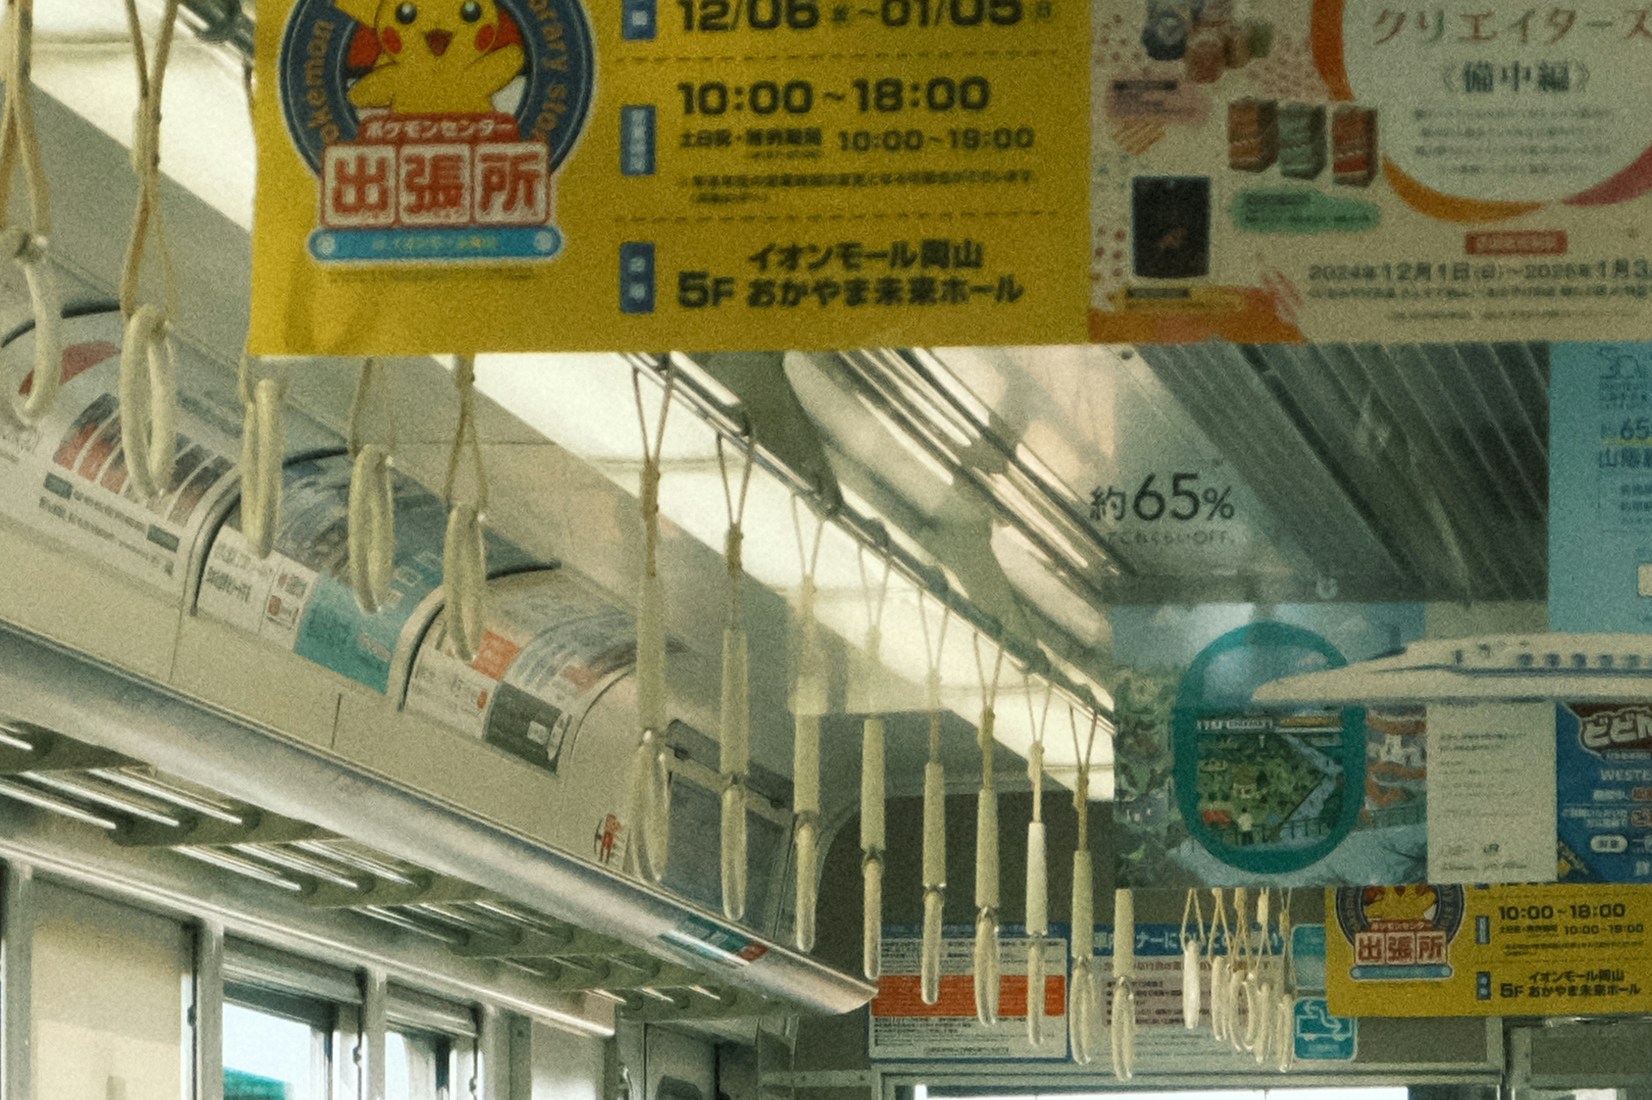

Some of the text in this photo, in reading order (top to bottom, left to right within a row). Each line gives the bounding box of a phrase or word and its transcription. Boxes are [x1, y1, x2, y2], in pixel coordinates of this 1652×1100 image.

[364, 120, 514, 139] ポケモンセンター
[333, 151, 540, 215] 出張所
[748, 238, 985, 272] イオンモール岡山
[677, 271, 735, 309] 5F
[747, 276, 1026, 309] おかやま未来ホール
[1089, 472, 1235, 521] 約65%
[1357, 936, 1445, 962] 出張所
[1499, 983, 1524, 999] 5F
[1528, 969, 1625, 984] イオンモール岡山
